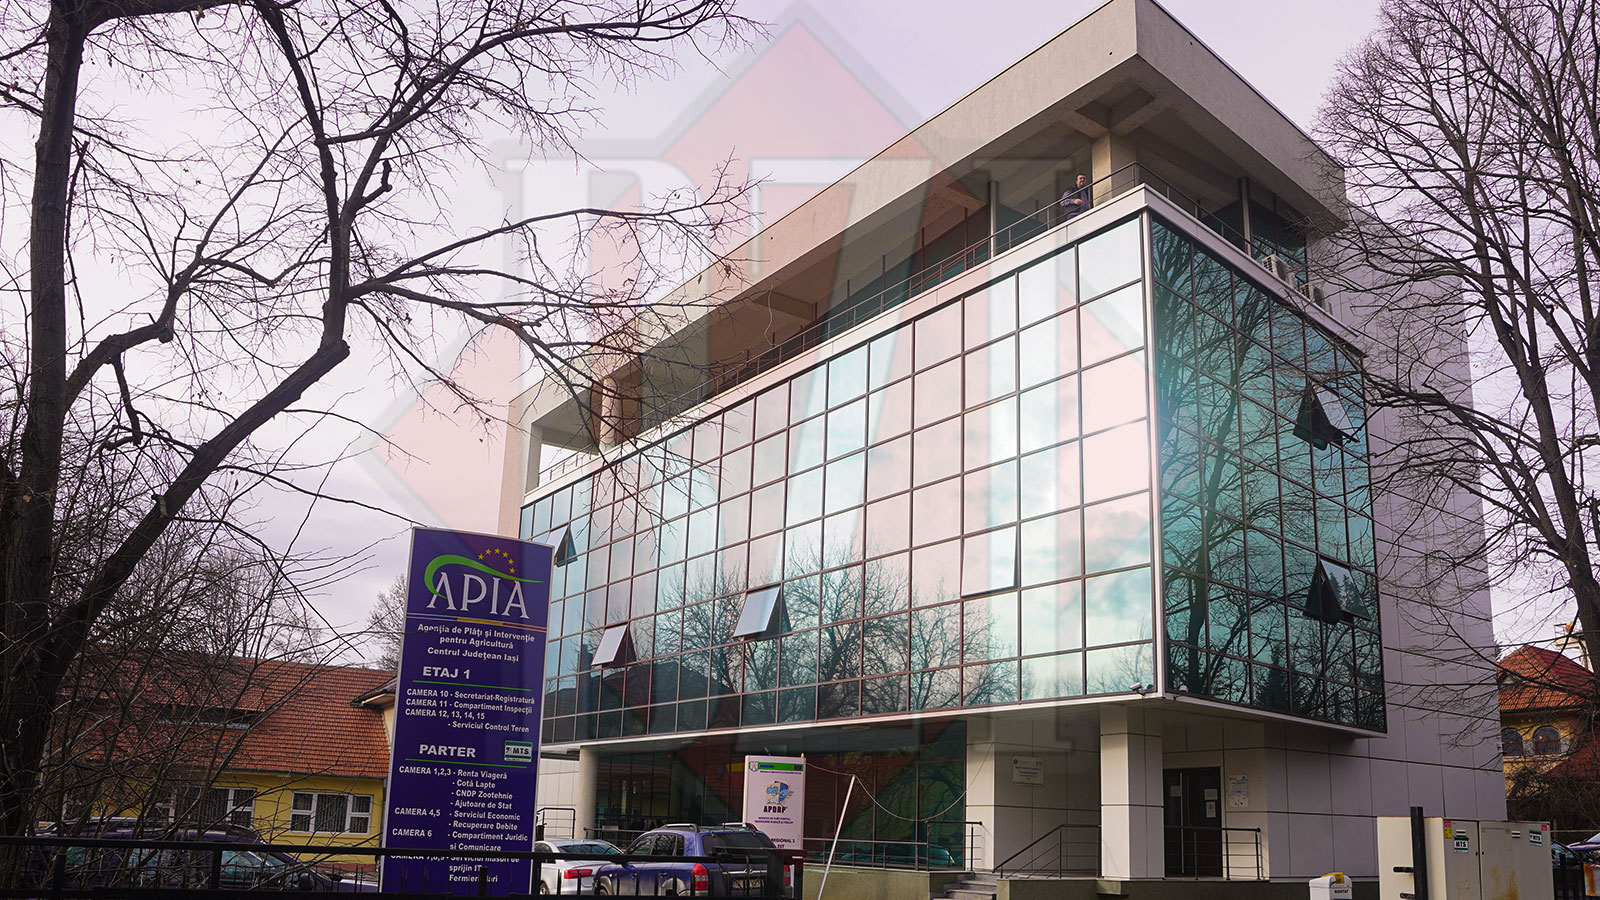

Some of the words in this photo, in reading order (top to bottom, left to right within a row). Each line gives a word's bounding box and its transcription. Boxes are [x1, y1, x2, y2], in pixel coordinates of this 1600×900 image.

[426, 572, 529, 619] APIA
[452, 626, 462, 634] de
[440, 636, 466, 646] pentru
[469, 638, 513, 649] Agricultură
[428, 647, 460, 656] Centrul
[423, 666, 458, 678] ETAJ
[464, 670, 470, 679] 1
[407, 689, 438, 697] CAMERA
[406, 699, 437, 707] CAMERA
[454, 702, 502, 711] Compartiment
[405, 709, 436, 717] CAMERA
[452, 711, 462, 719] 13,
[485, 723, 509, 731] Control
[511, 724, 529, 732] Teren
[420, 745, 476, 757] PARTER
[399, 766, 431, 774] CAMERA
[434, 768, 451, 776] 1,2,3
[456, 790, 476, 798] CNDP
[478, 791, 512, 799] Zootehnie
[455, 800, 486, 808] Ajutoare
[498, 802, 512, 810] Stat
[395, 808, 426, 816] CAMERA
[429, 809, 440, 817] 4,5
[454, 811, 485, 819] Serviciul
[488, 812, 520, 820] Economic
[453, 821, 494, 829] Recuperare
[392, 829, 425, 837] CAMERA
[452, 832, 503, 841] Compartiment
[505, 834, 528, 842] Juridic
[449, 864, 472, 873] sprijin
